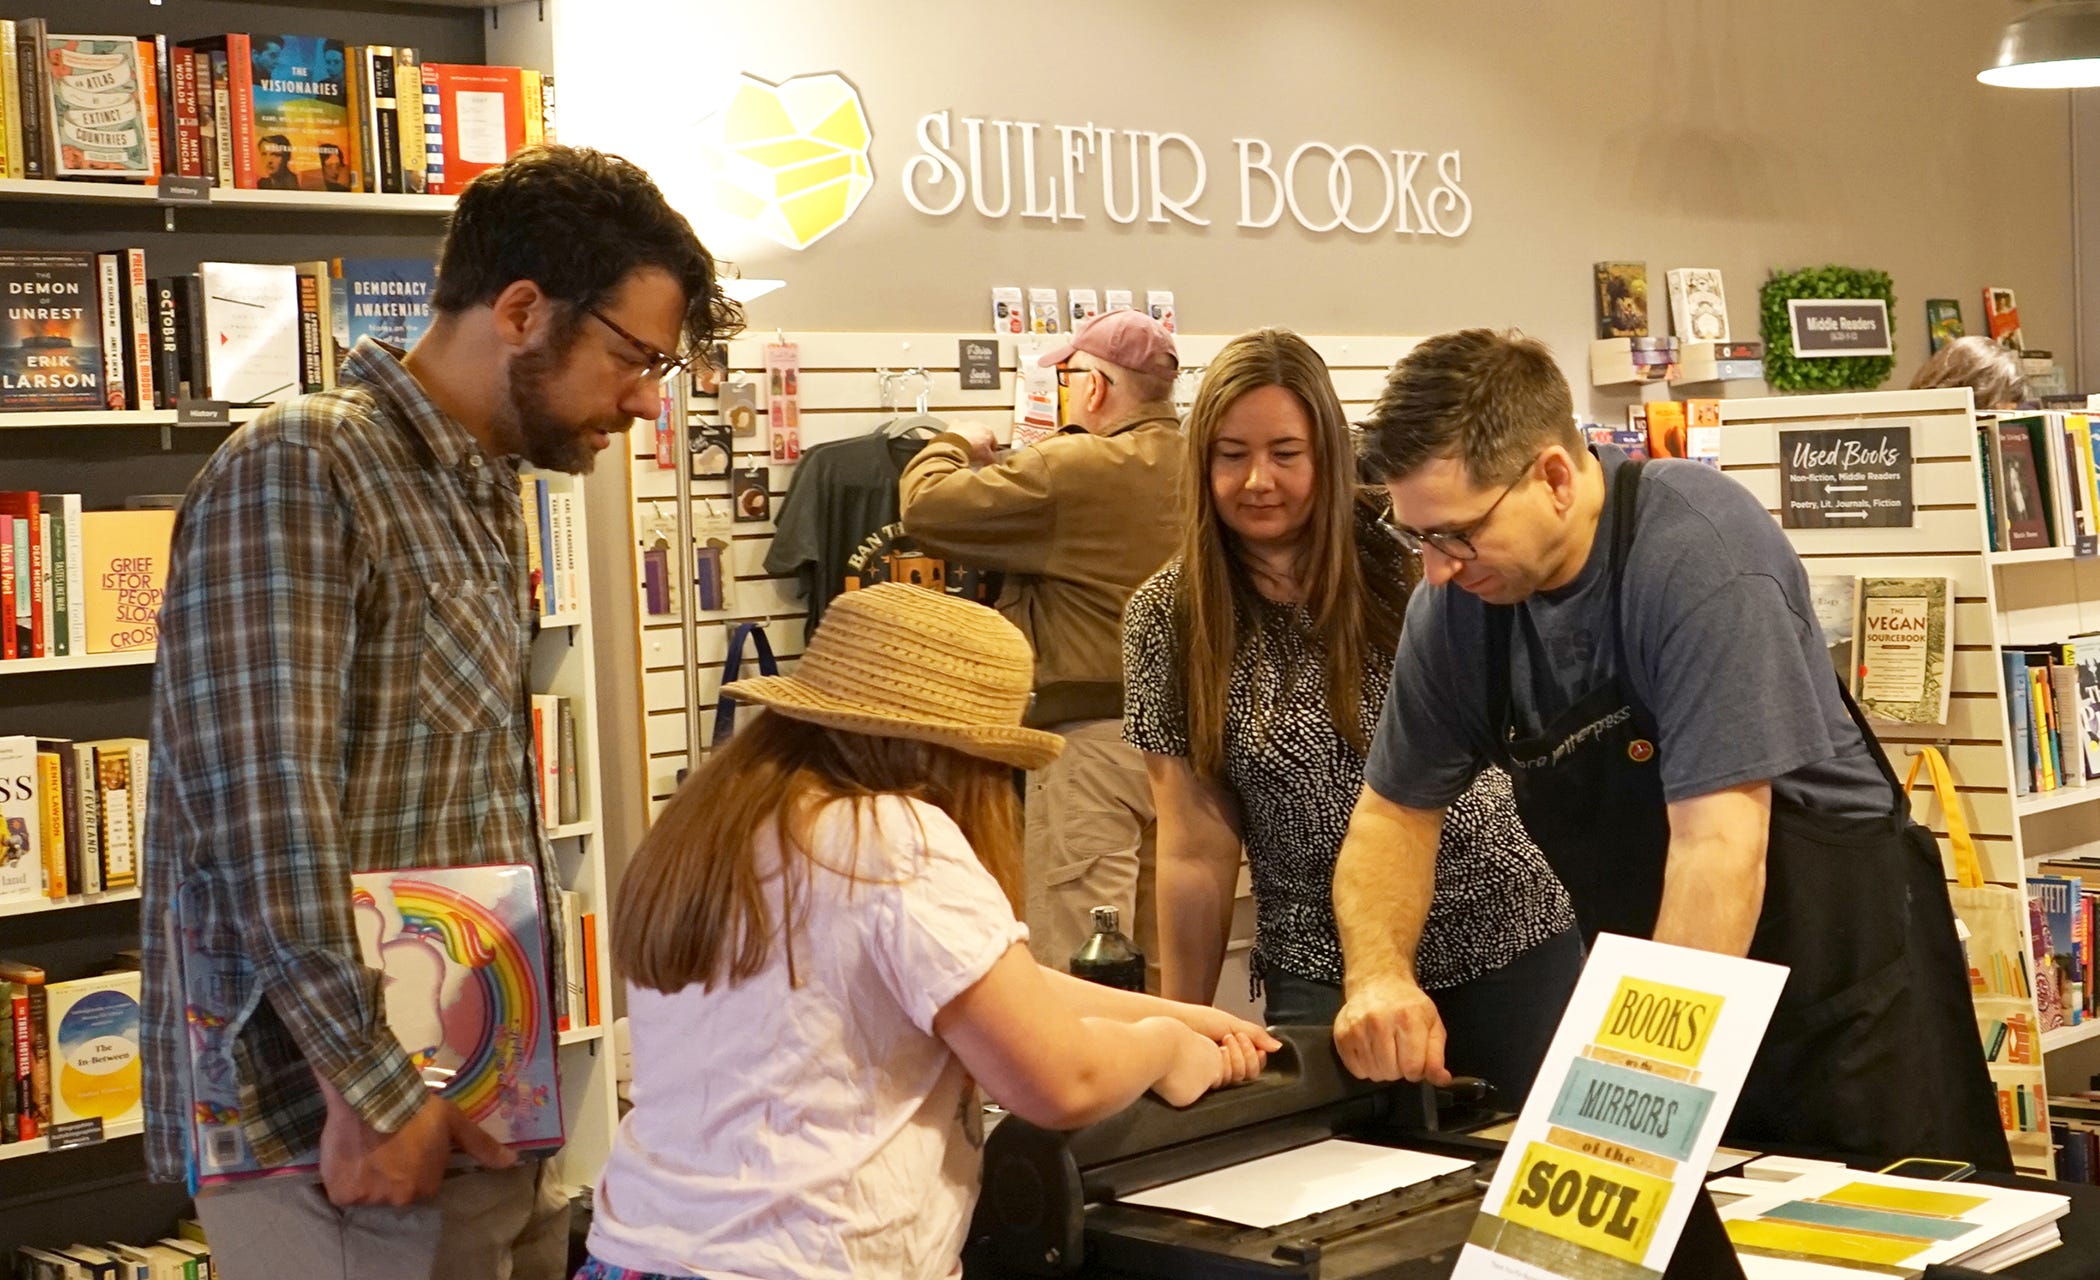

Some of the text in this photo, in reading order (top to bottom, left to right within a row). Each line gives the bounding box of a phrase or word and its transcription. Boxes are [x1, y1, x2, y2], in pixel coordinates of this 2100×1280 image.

[184, 55, 193, 80] HERO
[292, 66, 307, 77] THE
[87, 73, 115, 90] ATLAS
[176, 64, 186, 104] WORLDS
[260, 79, 338, 96] VISIONARIES
[187, 91, 196, 114] TWO
[82, 109, 122, 125] EXTINCT
[219, 106, 228, 129] WORST
[76, 128, 127, 146] COUNTRIES
[221, 132, 229, 152] HARD
[180, 131, 190, 171] DUNCAN
[190, 139, 199, 163] MIKE
[901, 109, 1473, 238] SULFUR BOOKS
[132, 253, 145, 286] PREQUEL
[9, 282, 79, 294] DEMON
[354, 281, 427, 296] DEMOCRACY
[8, 308, 83, 320] UNREST
[160, 289, 177, 352] OCTOBER
[354, 303, 429, 317] AWAKENING
[1807, 316, 1876, 331] Middle Readers
[137, 333, 150, 362] RACHEL
[27, 356, 72, 368] ERIK
[3, 373, 96, 389] LARSON
[140, 365, 152, 400] MADDOW
[1792, 435, 1901, 471] Used Books
[1789, 472, 1901, 482] Non-fiction, Middle Readers
[1790, 499, 1902, 510] Poetry, Lit. Journals, Fiction
[1, 543, 13, 565] Also
[848, 521, 905, 572] BAN TH
[32, 545, 42, 603] DEAR MEMORY
[111, 557, 153, 573] GRIEF
[2, 574, 14, 595] Poet
[102, 573, 151, 589] IS FOR
[118, 588, 166, 607] PEOPL
[116, 606, 158, 622] SLOA
[1868, 616, 1926, 631] VEGAN
[111, 626, 159, 648] CROSL
[1867, 634, 1926, 642] SOURCEBOOK
[134, 752, 144, 813] ADMISSIONS
[50, 761, 60, 837] JENNY LAWSON
[84, 789, 96, 854] FEVERLAND
[17, 1016, 29, 1040] THREE
[1610, 988, 1707, 1053] BOOKS
[95, 1044, 113, 1053] The
[78, 1052, 130, 1067] In-Between
[1578, 1078, 1679, 1139] MIRRORS
[1582, 1142, 1635, 1165] of the
[1517, 1159, 1642, 1242] SOUL
